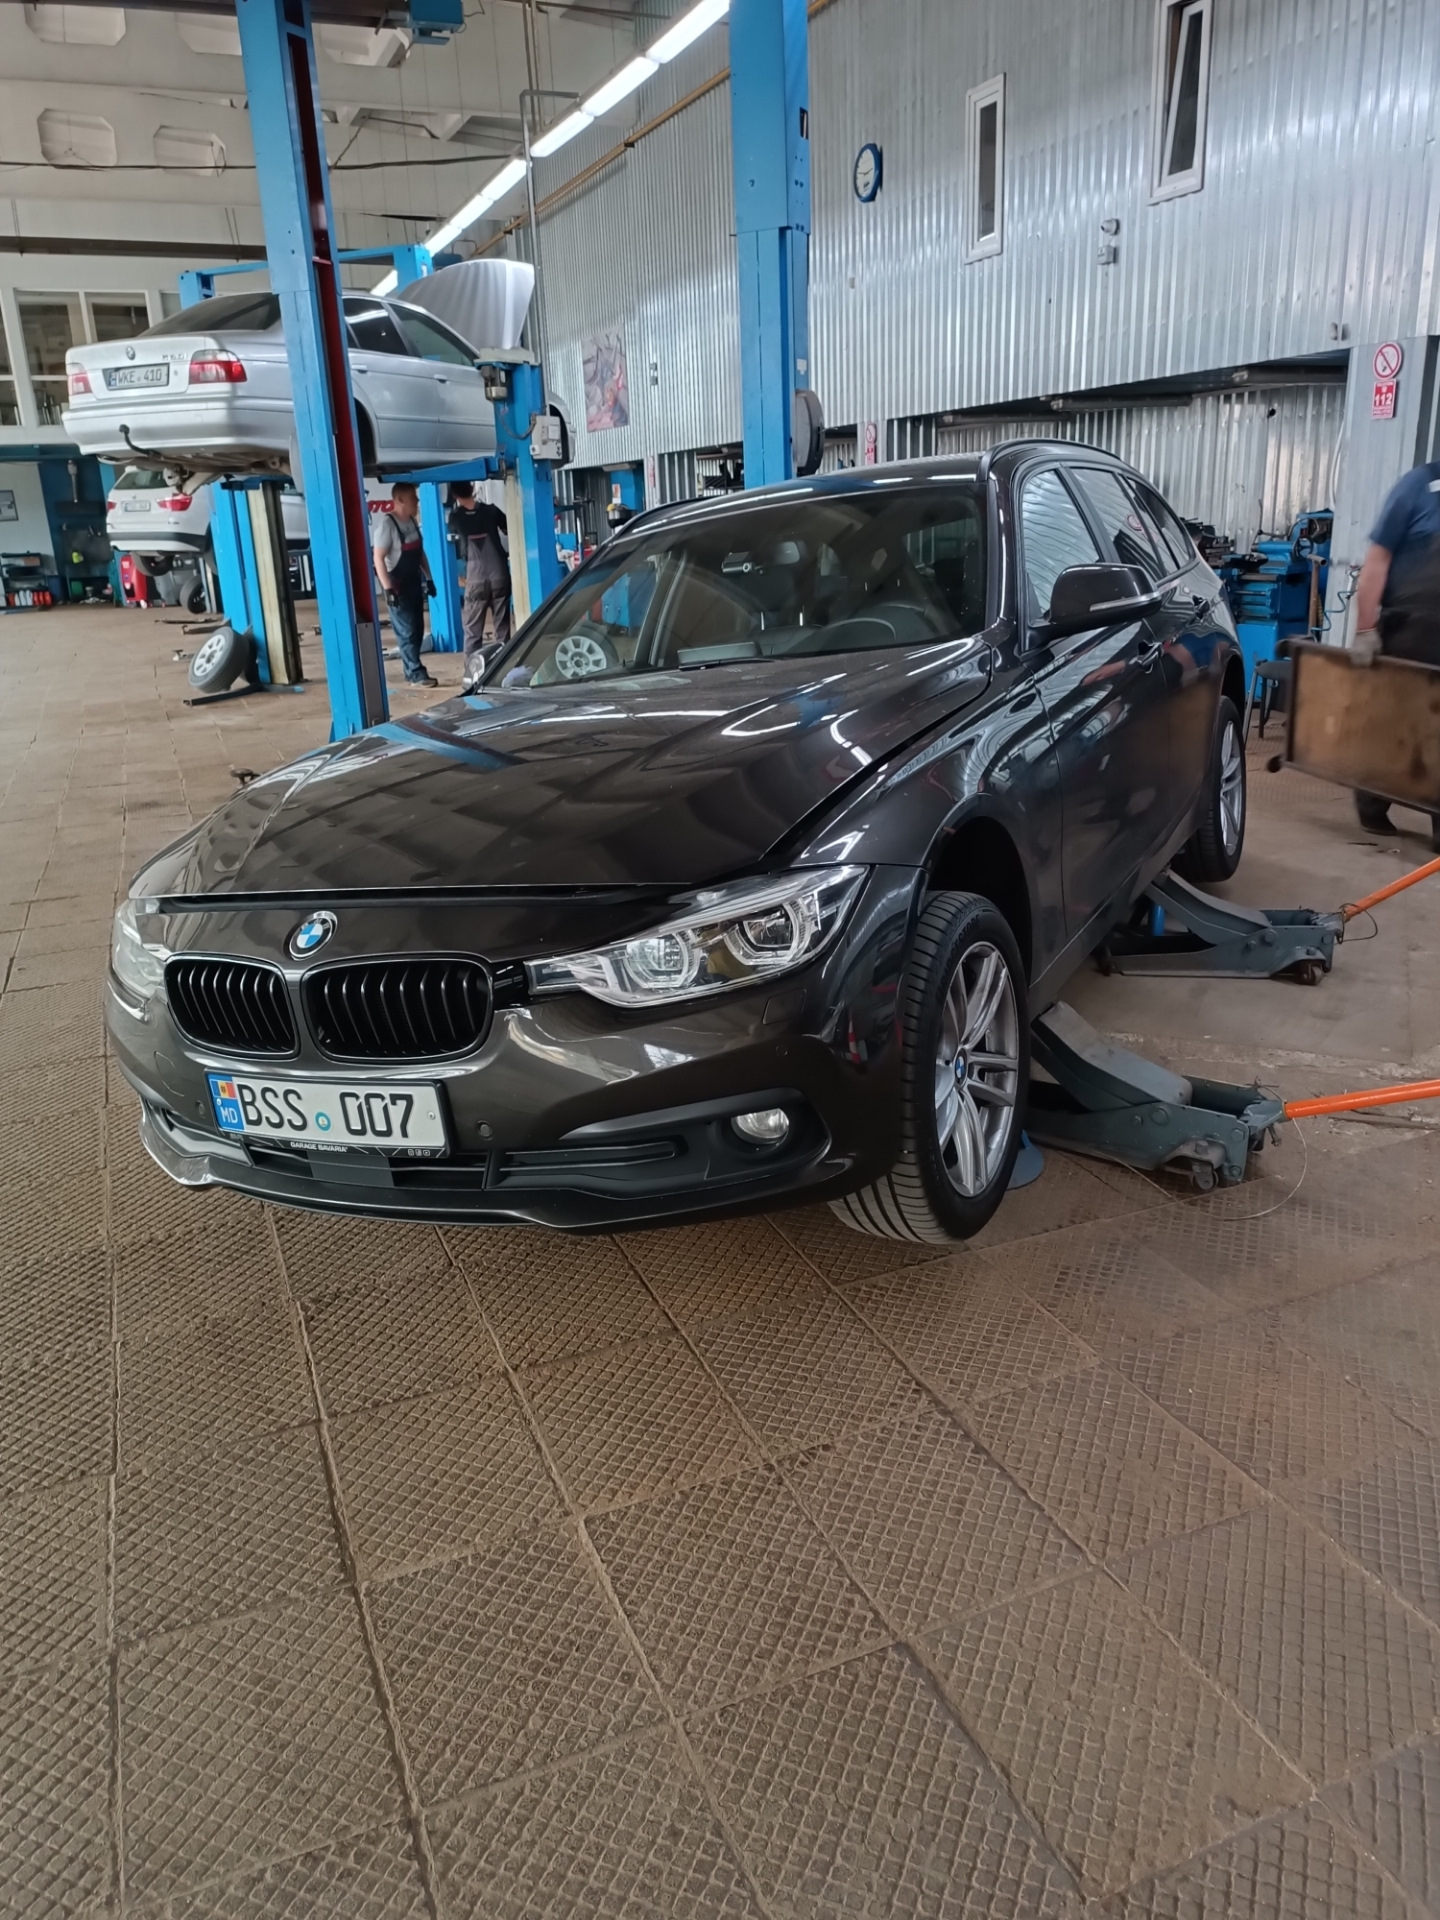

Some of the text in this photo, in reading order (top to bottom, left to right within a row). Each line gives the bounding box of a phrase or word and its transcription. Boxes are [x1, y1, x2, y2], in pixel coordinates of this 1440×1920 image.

[118, 368, 162, 384] WKE 410
[1375, 392, 1393, 406] 112
[368, 500, 394, 513] TO
[221, 1105, 238, 1123] MD
[236, 1083, 414, 1139] BSS 007
[290, 1141, 318, 1150] GARAGE
